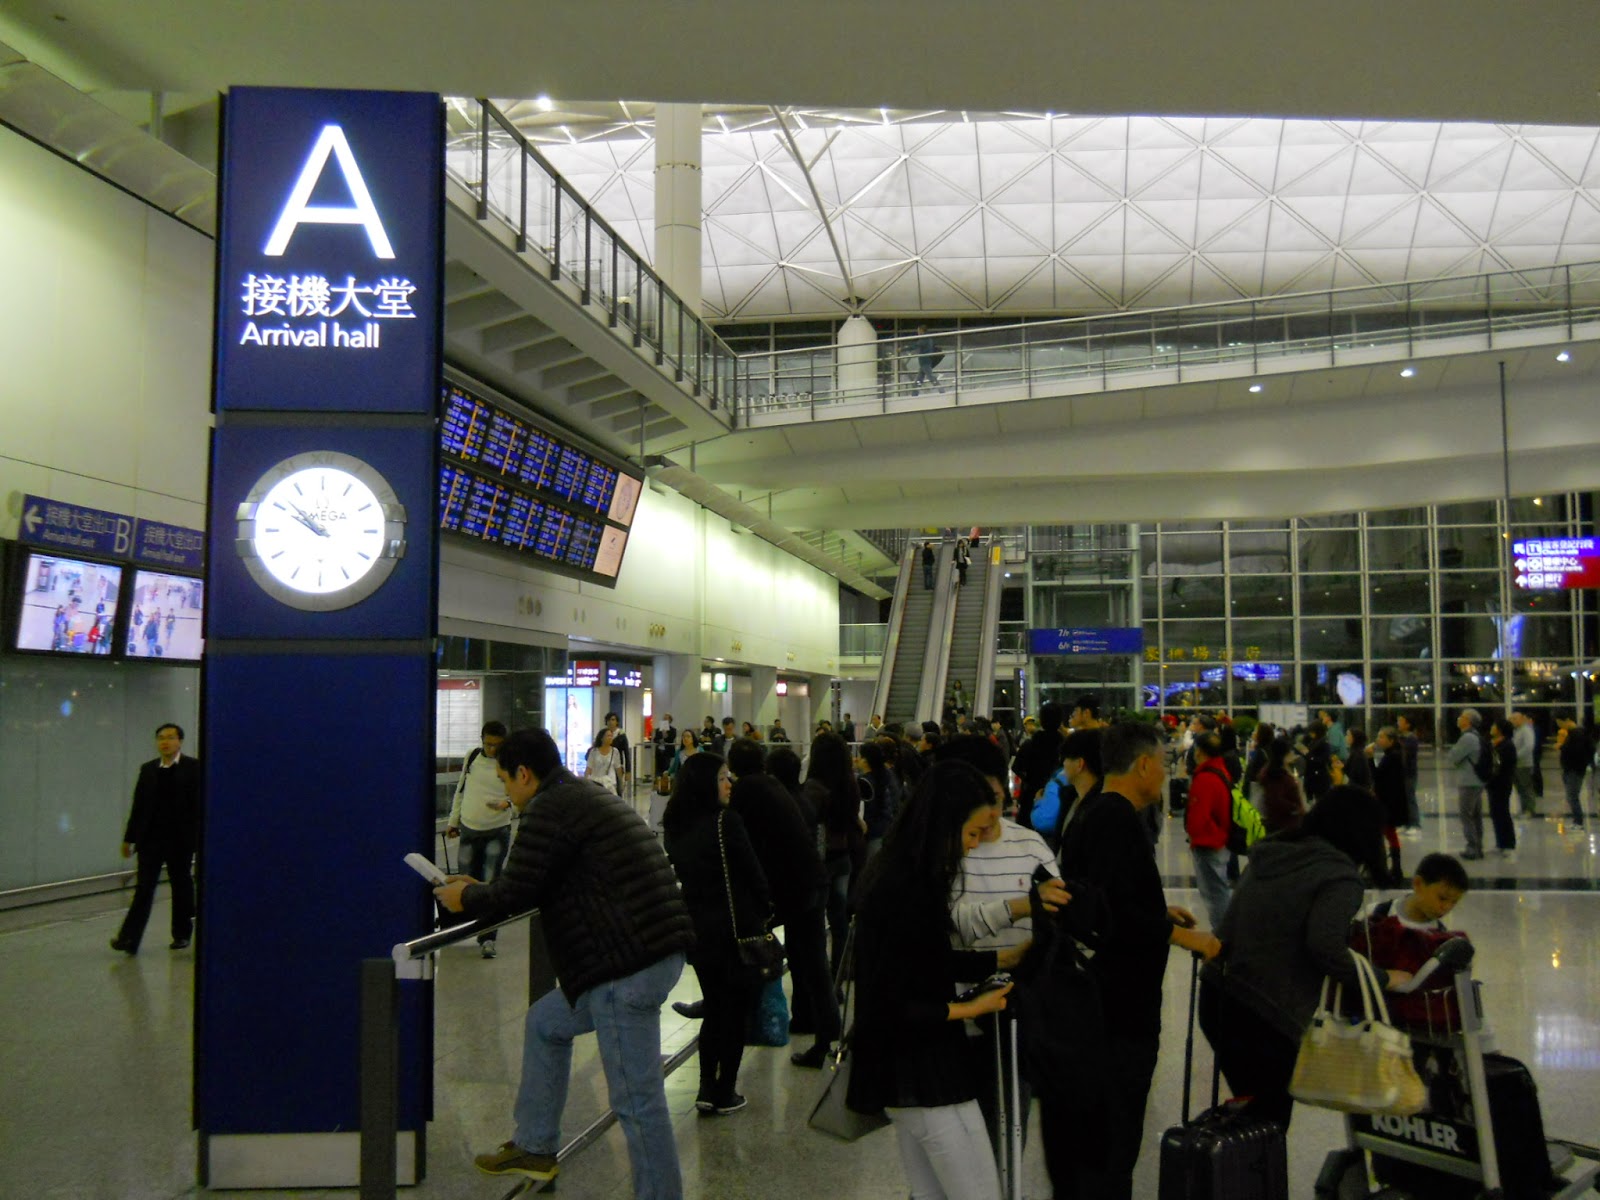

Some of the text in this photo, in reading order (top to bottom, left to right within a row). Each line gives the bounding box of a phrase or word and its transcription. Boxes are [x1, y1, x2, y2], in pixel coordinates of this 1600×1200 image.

[263, 124, 397, 259] A
[241, 273, 417, 319] 接機大堂
[239, 321, 380, 348] Arrival hall
[298, 510, 347, 521] OMEGA
[113, 518, 131, 554] B
[1371, 1113, 1461, 1152] KOHLER
